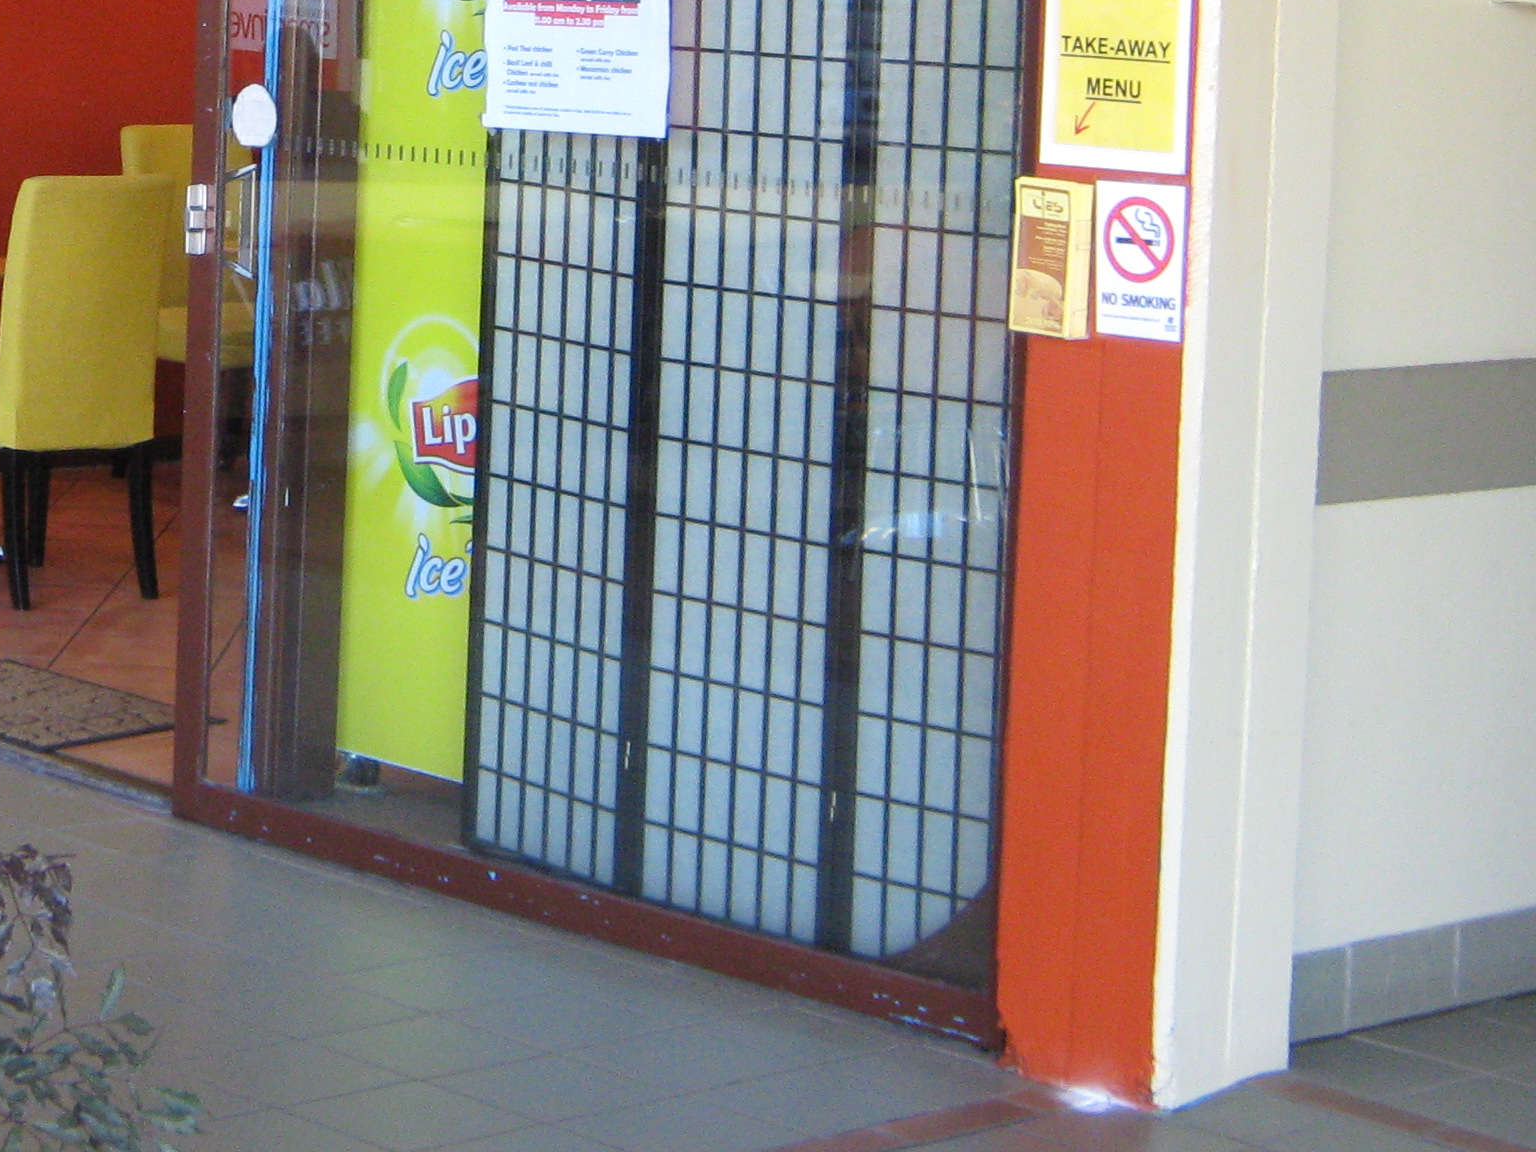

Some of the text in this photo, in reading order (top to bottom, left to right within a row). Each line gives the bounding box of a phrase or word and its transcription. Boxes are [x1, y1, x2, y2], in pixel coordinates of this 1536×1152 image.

[556, 2, 586, 15] Monday
[595, 4, 620, 16] Friday
[1061, 35, 1172, 59] TAKE-AWAY
[1086, 76, 1142, 99] MENU
[1101, 291, 1177, 311] NO SMOKING
[421, 404, 478, 456] Lip
